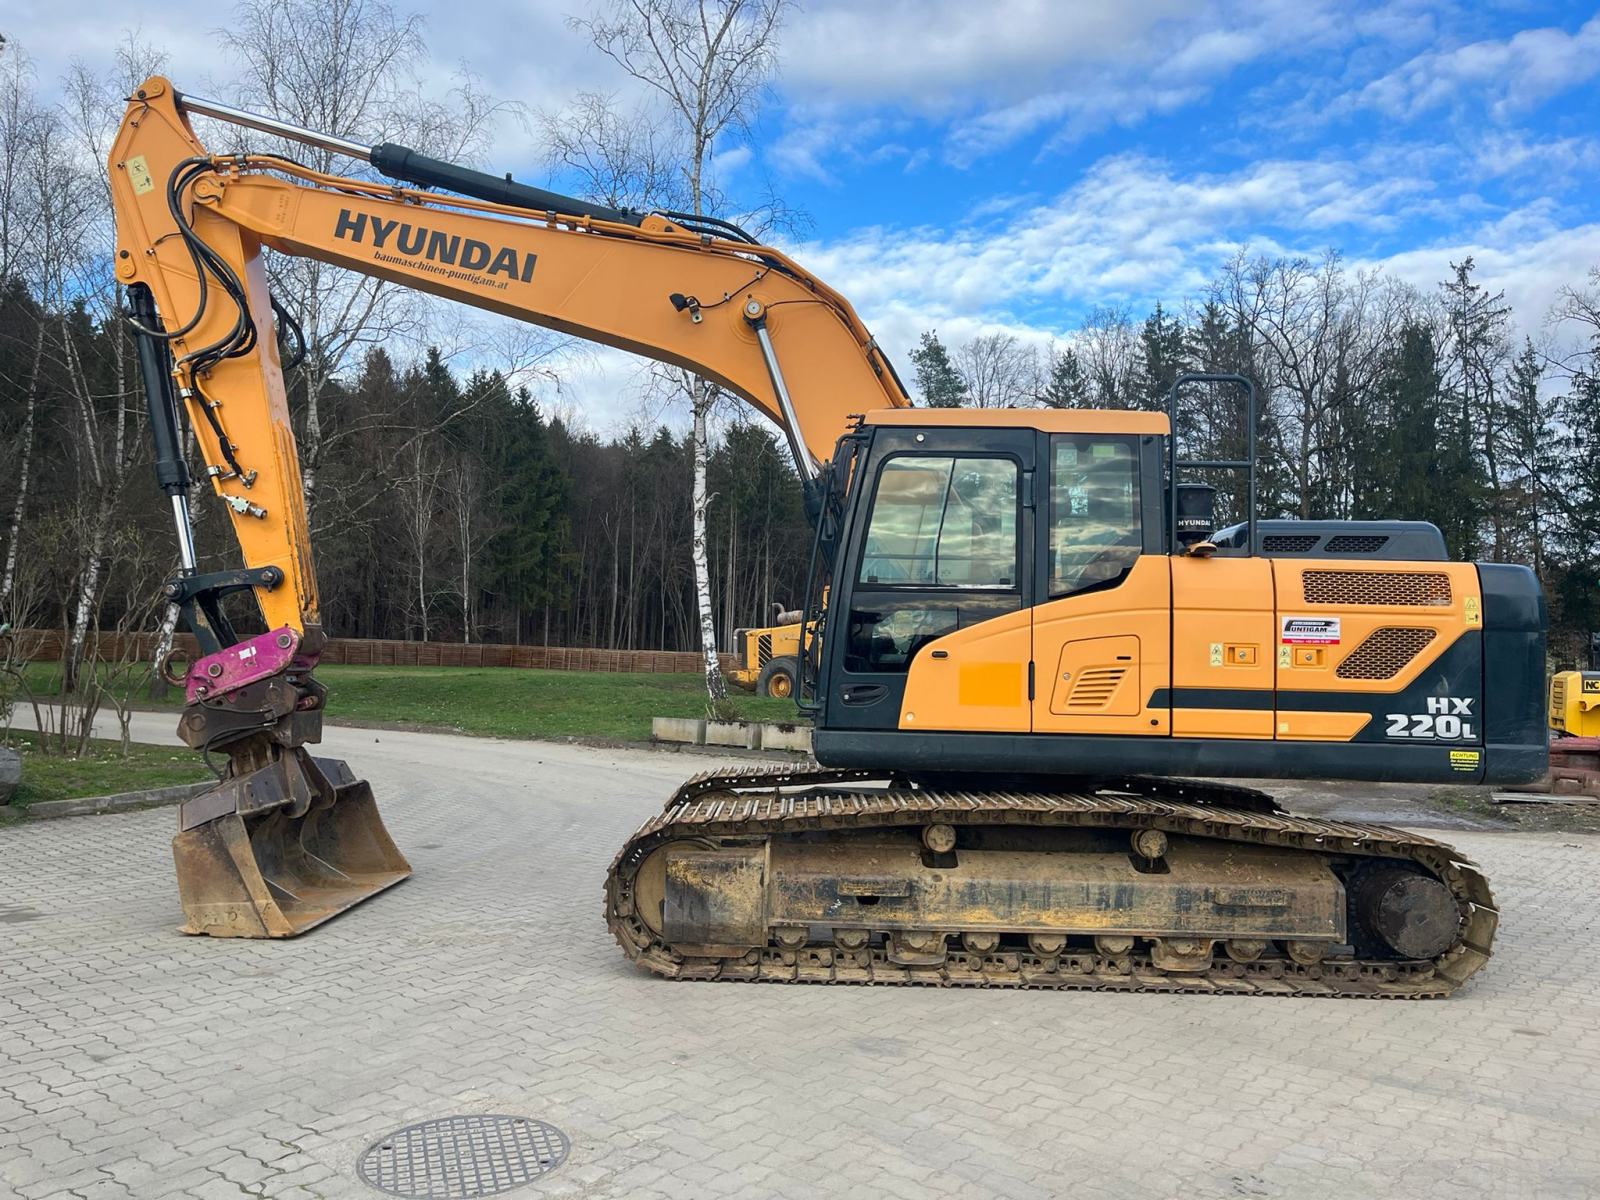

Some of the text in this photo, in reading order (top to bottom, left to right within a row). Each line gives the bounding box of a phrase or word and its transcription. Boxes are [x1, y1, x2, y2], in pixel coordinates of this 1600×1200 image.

[334, 208, 538, 284] HYUNDAI
[373, 250, 508, 291] baumaschinen-puntigam.at
[1426, 697, 1474, 715] HX
